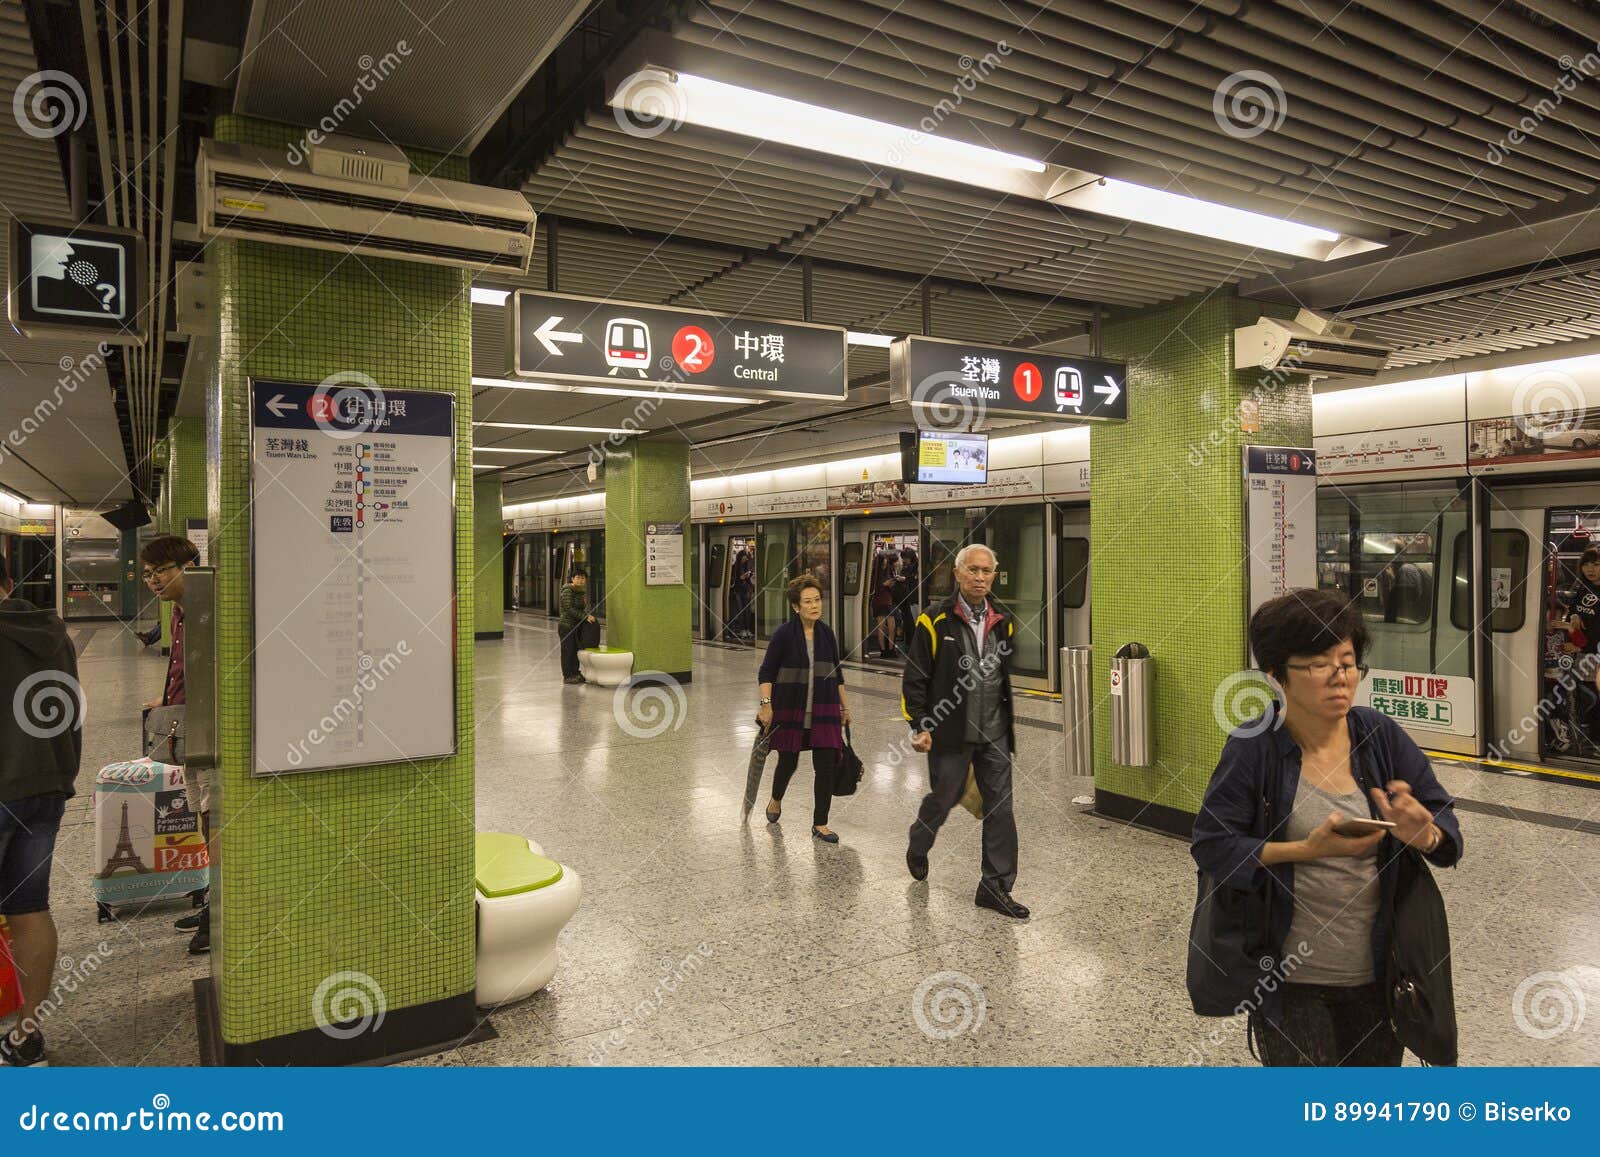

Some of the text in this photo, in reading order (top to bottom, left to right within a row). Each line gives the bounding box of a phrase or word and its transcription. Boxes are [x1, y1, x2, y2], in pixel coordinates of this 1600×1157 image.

[682, 334, 702, 364] 2
[734, 331, 784, 363] 中環
[734, 365, 778, 382] Central
[961, 355, 1000, 384] 荃灣
[949, 383, 1000, 400] Tsuen Wan
[1022, 369, 1032, 395] 1
[315, 399, 329, 418] 2
[345, 396, 406, 417] 往中環
[346, 417, 391, 426] to Central
[1373, 697, 1449, 723] 先落後上
[160, 848, 210, 870] PAR
